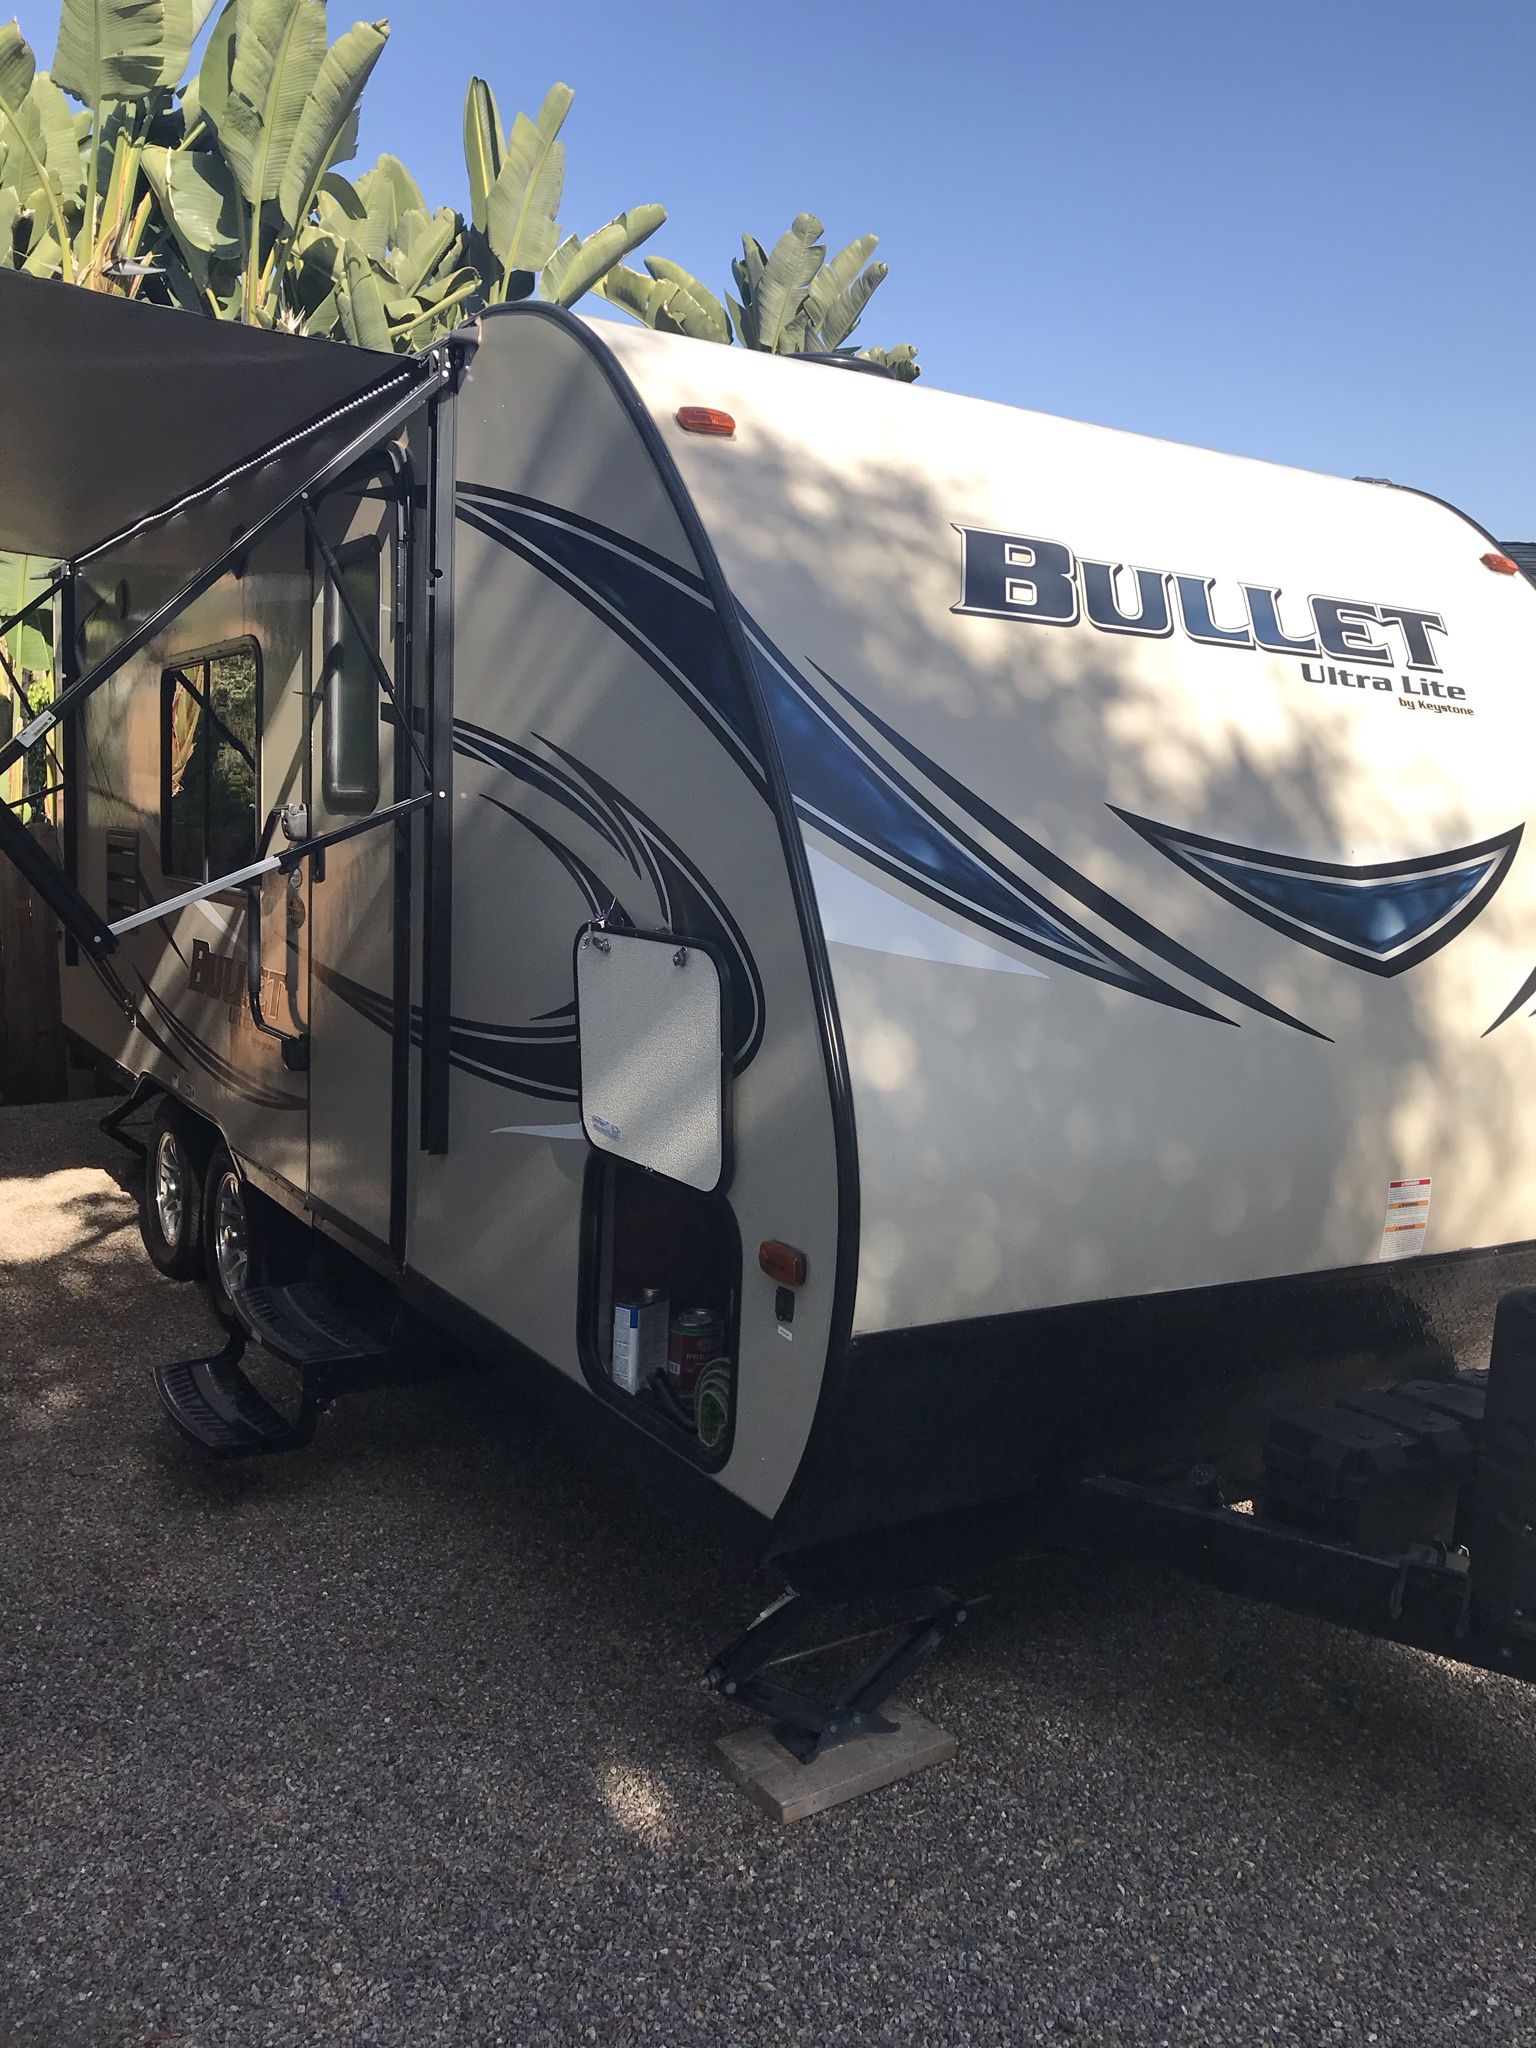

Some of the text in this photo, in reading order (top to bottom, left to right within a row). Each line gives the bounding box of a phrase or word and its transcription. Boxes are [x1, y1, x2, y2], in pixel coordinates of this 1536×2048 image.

[949, 522, 1448, 674] BULLET
[1301, 663, 1466, 700] Ultra Lite
[1398, 697, 1475, 716] by Keystone
